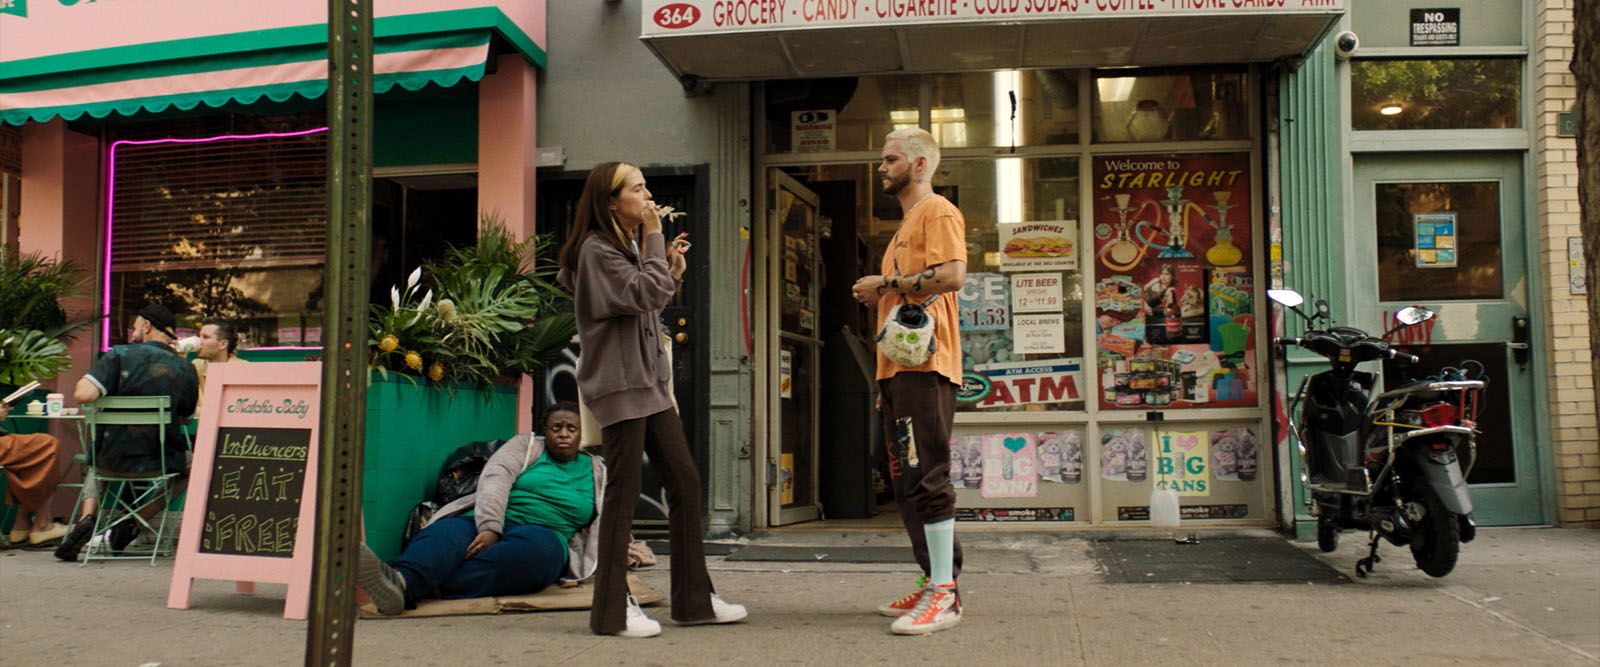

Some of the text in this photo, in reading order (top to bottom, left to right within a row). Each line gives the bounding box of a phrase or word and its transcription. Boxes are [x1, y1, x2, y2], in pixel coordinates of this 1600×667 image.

[660, 6, 694, 25] 364
[713, 0, 785, 27] GROCERY
[802, 0, 857, 22] CANDY
[875, 0, 957, 18] CIGARETTE
[1424, 12, 1444, 22] NO
[1413, 22, 1457, 34] TRESPASSING
[1105, 160, 1180, 171] Welcome to
[1100, 170, 1243, 189] STARLIGHT
[1012, 224, 1065, 235] SANDWICHES
[959, 277, 1005, 301] CE
[1016, 278, 1058, 288] LITE BEER
[1018, 298, 1027, 308] 12
[1038, 318, 1060, 326] BREWS
[982, 375, 1080, 405] ATM
[227, 398, 310, 419] Matcha Baby
[219, 433, 307, 459] Influencers
[1161, 434, 1172, 453] I
[220, 470, 294, 500] EAT
[215, 513, 293, 552] FREE
